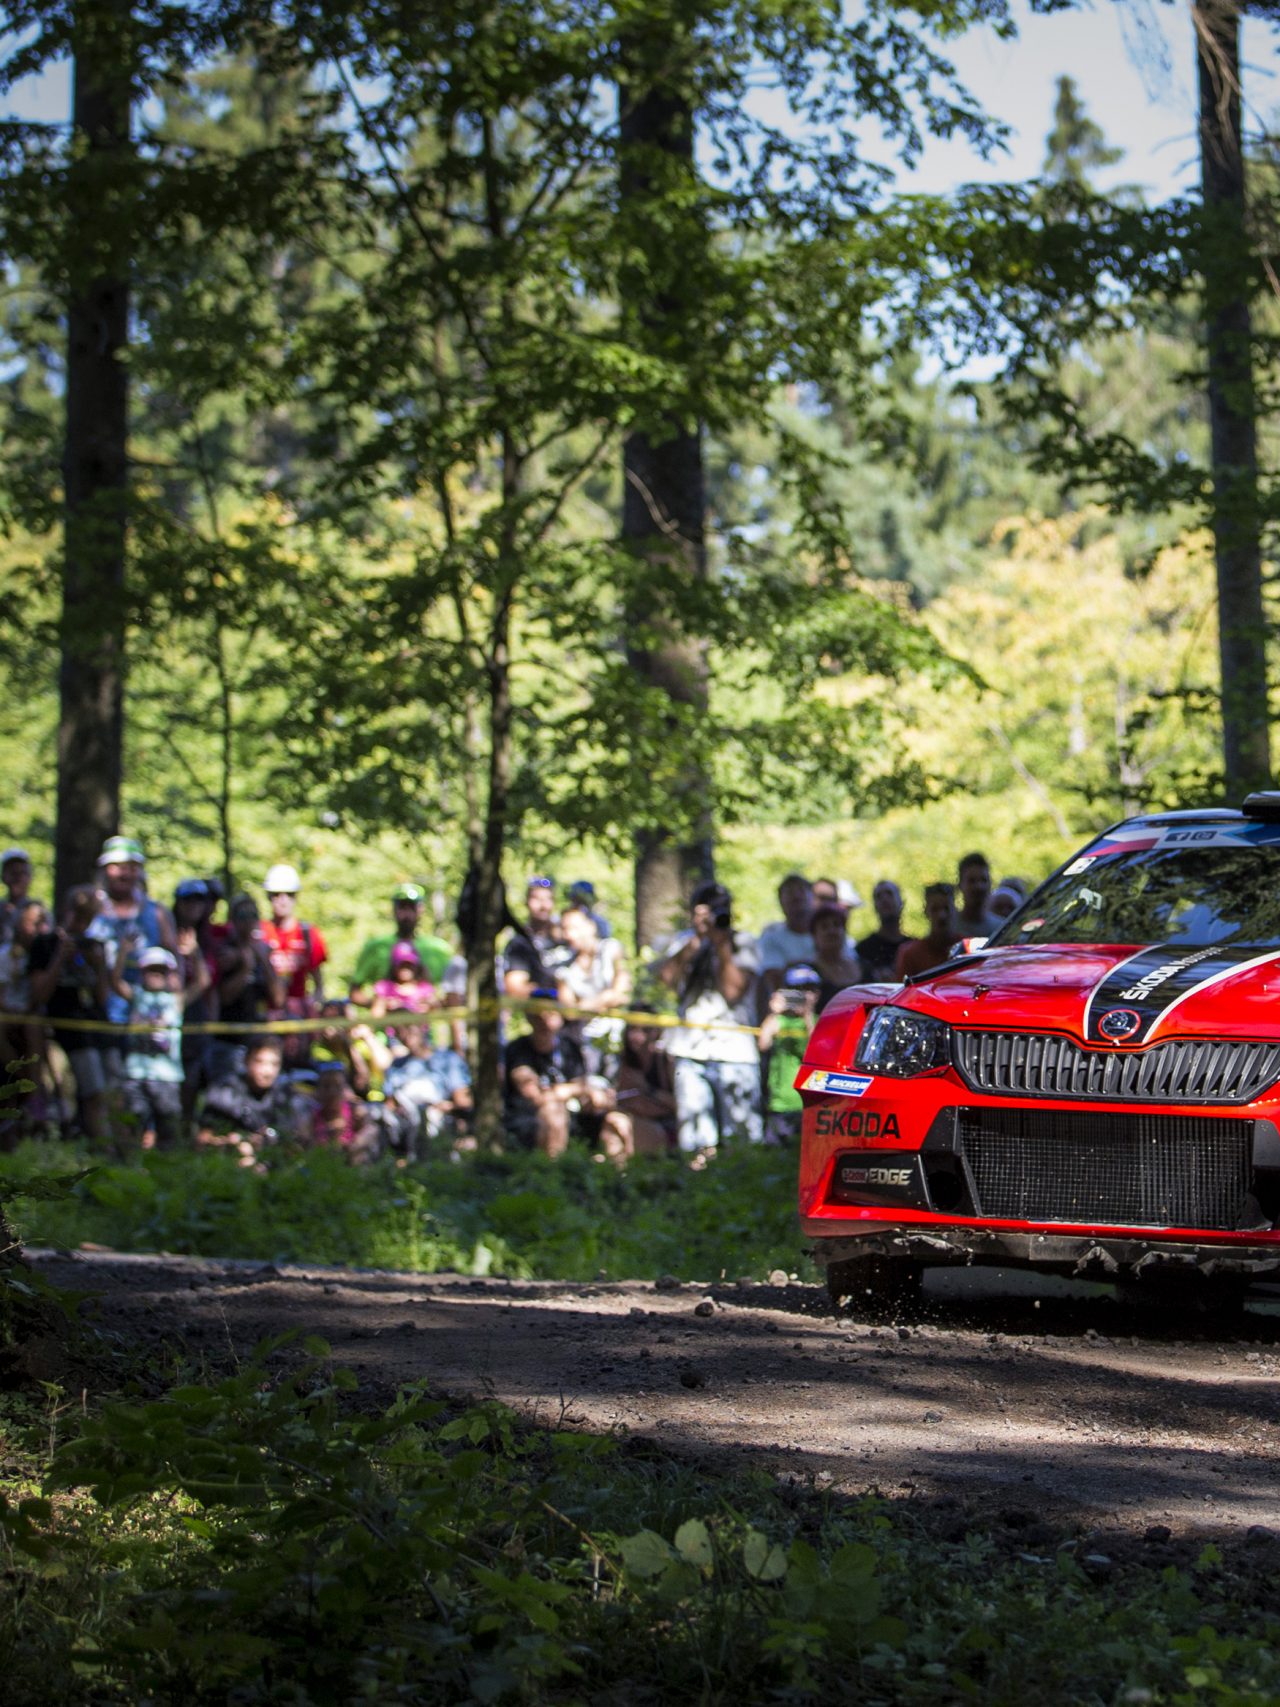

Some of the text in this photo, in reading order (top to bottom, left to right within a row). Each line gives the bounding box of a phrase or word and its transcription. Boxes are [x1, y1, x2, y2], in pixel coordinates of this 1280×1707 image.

[1119, 965, 1186, 1000] ŠKODA
[815, 1105, 901, 1139] ŠKODA
[868, 1167, 913, 1186] EDGE
